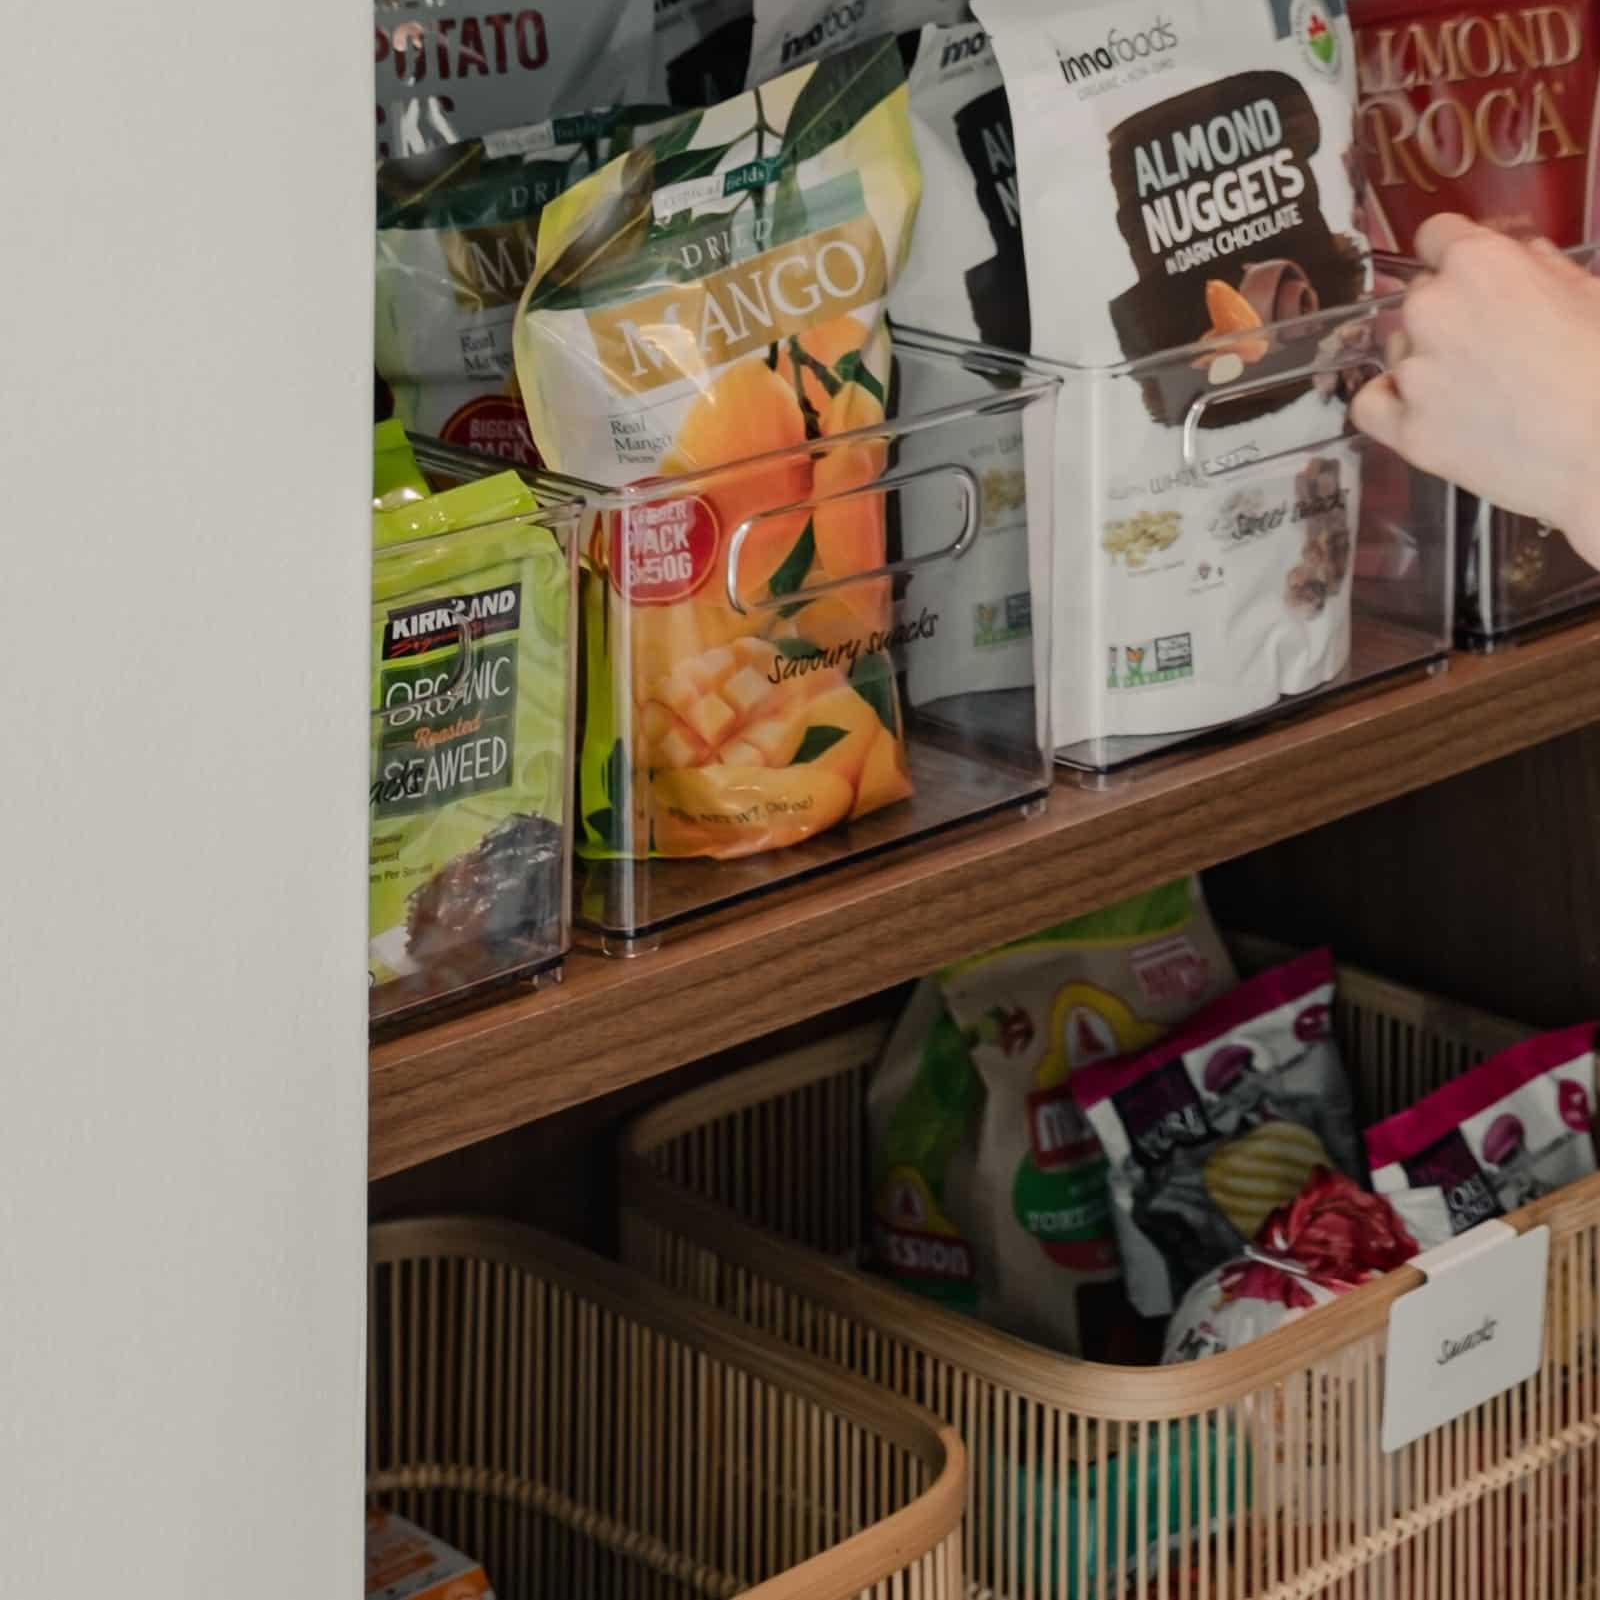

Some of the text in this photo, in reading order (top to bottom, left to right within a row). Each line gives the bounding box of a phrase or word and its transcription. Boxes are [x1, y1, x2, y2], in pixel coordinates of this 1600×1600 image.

[1053, 13, 1180, 86] innofoods
[1133, 97, 1283, 198] ALMOND
[1355, 80, 1587, 193] ROCA
[1140, 147, 1305, 255] NUGGETS
[1175, 235, 1219, 273] DARK
[1216, 203, 1304, 256] CHOCOLATE
[616, 239, 867, 379] MANGO
[609, 412, 646, 437] Real
[613, 431, 673, 455] Mango
[767, 607, 940, 686] Savoury snacks
[413, 711, 482, 750] Roasted
[384, 736, 508, 802] SEAWEED
